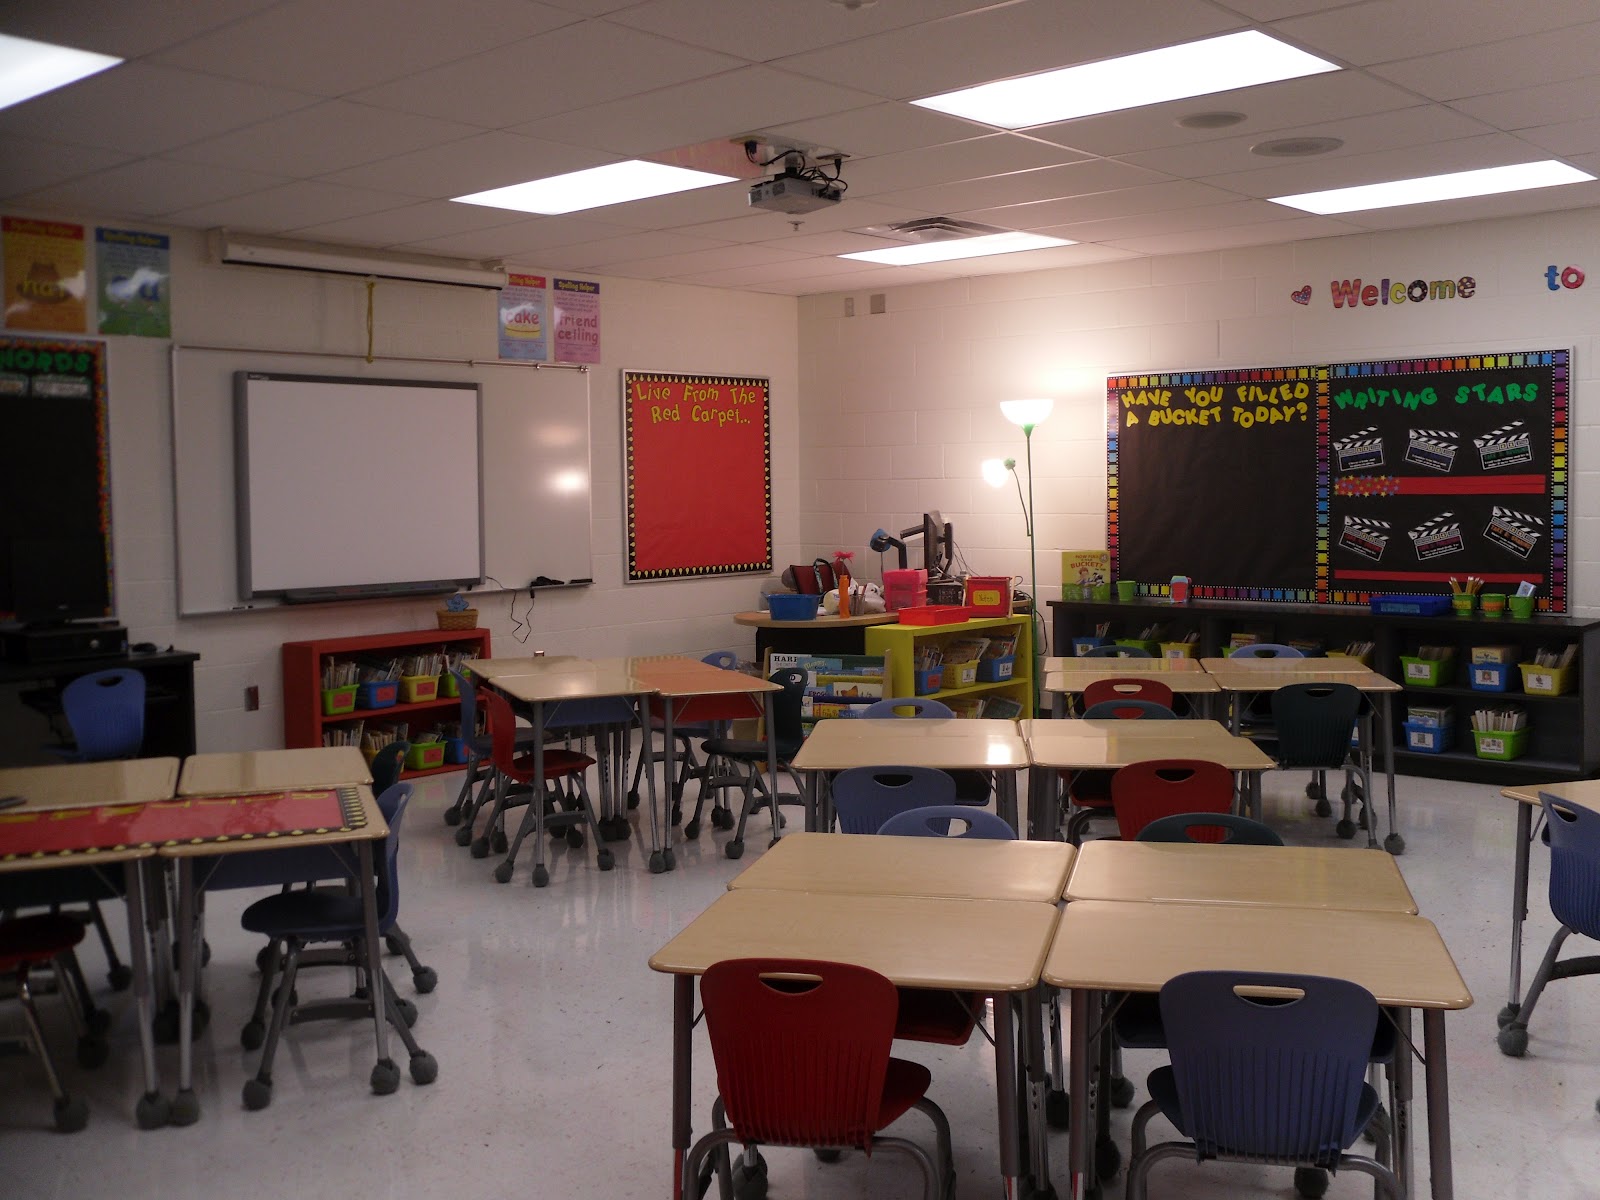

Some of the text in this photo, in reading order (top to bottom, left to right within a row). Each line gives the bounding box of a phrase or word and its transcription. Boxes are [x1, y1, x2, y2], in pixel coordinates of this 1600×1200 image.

[1330, 265, 1585, 309] Welcome to
[506, 309, 539, 325] cake
[558, 328, 599, 346] ceiling
[636, 383, 756, 405] Live From The
[1121, 382, 1309, 408] HAVE YOU FILLED
[1334, 383, 1538, 410] WRITING STARS
[651, 404, 680, 423] Red
[1126, 403, 1308, 428] A BUCKET TODAY?
